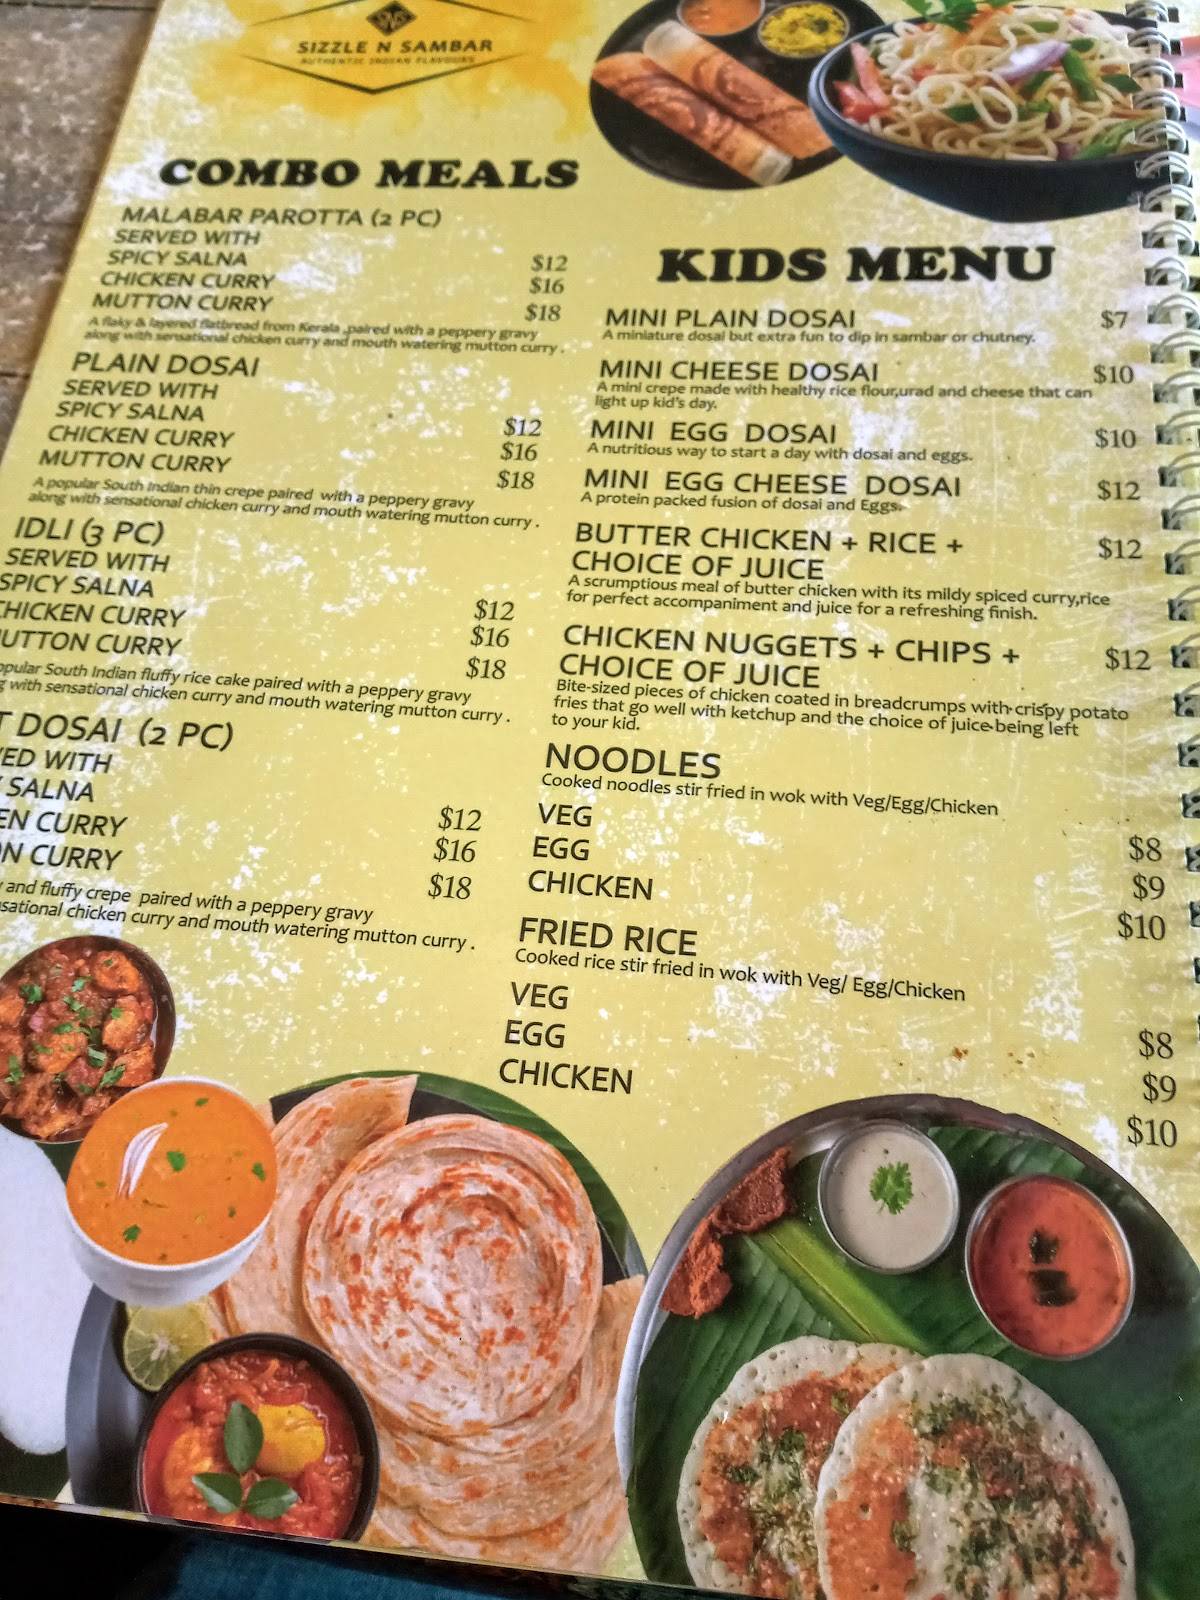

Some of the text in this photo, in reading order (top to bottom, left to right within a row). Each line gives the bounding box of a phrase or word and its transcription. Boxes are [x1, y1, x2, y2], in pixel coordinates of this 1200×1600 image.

[298, 39, 492, 54] SIZZLE N SAMBAR
[159, 158, 580, 188] COMBO MEALS
[122, 207, 442, 228] MALABAR PAROTTA (2 PC)
[114, 230, 261, 245] SERVED WITH
[108, 250, 248, 266] SPICY SALNA
[531, 255, 568, 272] $12
[657, 246, 1056, 283] KIDS MENU
[101, 272, 276, 289] CHICKEN CURRY
[529, 277, 564, 294] $16
[92, 294, 273, 312] MUTTON CURRY
[525, 304, 562, 322] $18
[605, 308, 856, 328] MINI PLAIN DOSAI
[1100, 311, 1128, 329] $7
[72, 352, 260, 377] PLAIN DOSAI
[600, 360, 878, 382] MINI CHEESE DOSAI
[1094, 366, 1134, 384] $10
[64, 380, 218, 400] SERVED WITH
[56, 401, 205, 422] SPICY SALNA
[595, 395, 718, 412] light up kid's day.
[48, 426, 234, 448] CHICKEN CURRY
[504, 416, 542, 436] $12
[590, 420, 836, 444] MINI EGG DOSAI
[1095, 428, 1136, 450] $10
[38, 450, 232, 472] MUTTON CURRY
[500, 442, 538, 461] $16
[496, 470, 535, 489] $18
[584, 468, 960, 496] MINI EGG CHEESE DOSAI
[1097, 480, 1140, 500] $12
[580, 492, 902, 514] A protein packed fusion of dosai and Eggs.
[14, 516, 164, 547] IDLI (3 PC)
[575, 522, 963, 554] BUTTER CHICKEN + RICE +
[4, 548, 170, 572] SERVED WITH
[1098, 538, 1143, 559] $12
[572, 550, 825, 580] CHOICE OF JUICE
[0, 573, 154, 598] SPICY SALNA
[101, 606, 186, 628] CURRY
[474, 599, 516, 621] $12
[0, 629, 182, 656] UTTON CURRY
[470, 625, 510, 648] $16
[564, 624, 1020, 664] CHICKEN NUGGETS + CHIPS +
[466, 656, 506, 680] $18
[560, 654, 820, 688] CHOICE OF JUICE
[1106, 647, 1151, 671] $12
[16, 712, 122, 743] DOSAI
[139, 717, 167, 746] (2
[178, 721, 234, 752] PC)
[552, 714, 640, 730] to your kid.
[44, 750, 113, 774] WITH
[545, 742, 722, 780] NOODLES
[6, 777, 94, 802] SALNA
[542, 774, 999, 816] Cooked noodles stir fried in wok with Veg/Egg/Chicken
[36, 812, 128, 837] CURRY
[438, 804, 482, 832] $12
[538, 802, 592, 827] VEG
[30, 844, 123, 870] CURRY
[434, 836, 477, 862] $16
[533, 836, 590, 860] EGG
[1128, 834, 1162, 861] $8
[428, 872, 472, 900] $18
[528, 870, 653, 900] CHICKEN
[1132, 872, 1164, 900] $9
[6, 880, 38, 894] and
[40, 881, 83, 901] fluffy
[87, 887, 131, 905] crepe
[138, 892, 192, 907] paired
[197, 895, 232, 910] with
[237, 900, 247, 911] a
[250, 902, 322, 920] peppery
[326, 906, 374, 924] gravy
[518, 916, 698, 957] FRIED RICE
[1118, 911, 1166, 940] $10
[515, 948, 966, 1001] Cooked rice stir fried in wok with Veg/ Egg/Chicken
[511, 981, 568, 1010] VEG
[504, 1019, 566, 1049] EGG
[1139, 1028, 1173, 1059] $8
[499, 1058, 633, 1094] CHICKEN
[1143, 1072, 1177, 1103] $9
[1128, 1114, 1178, 1148] $10
